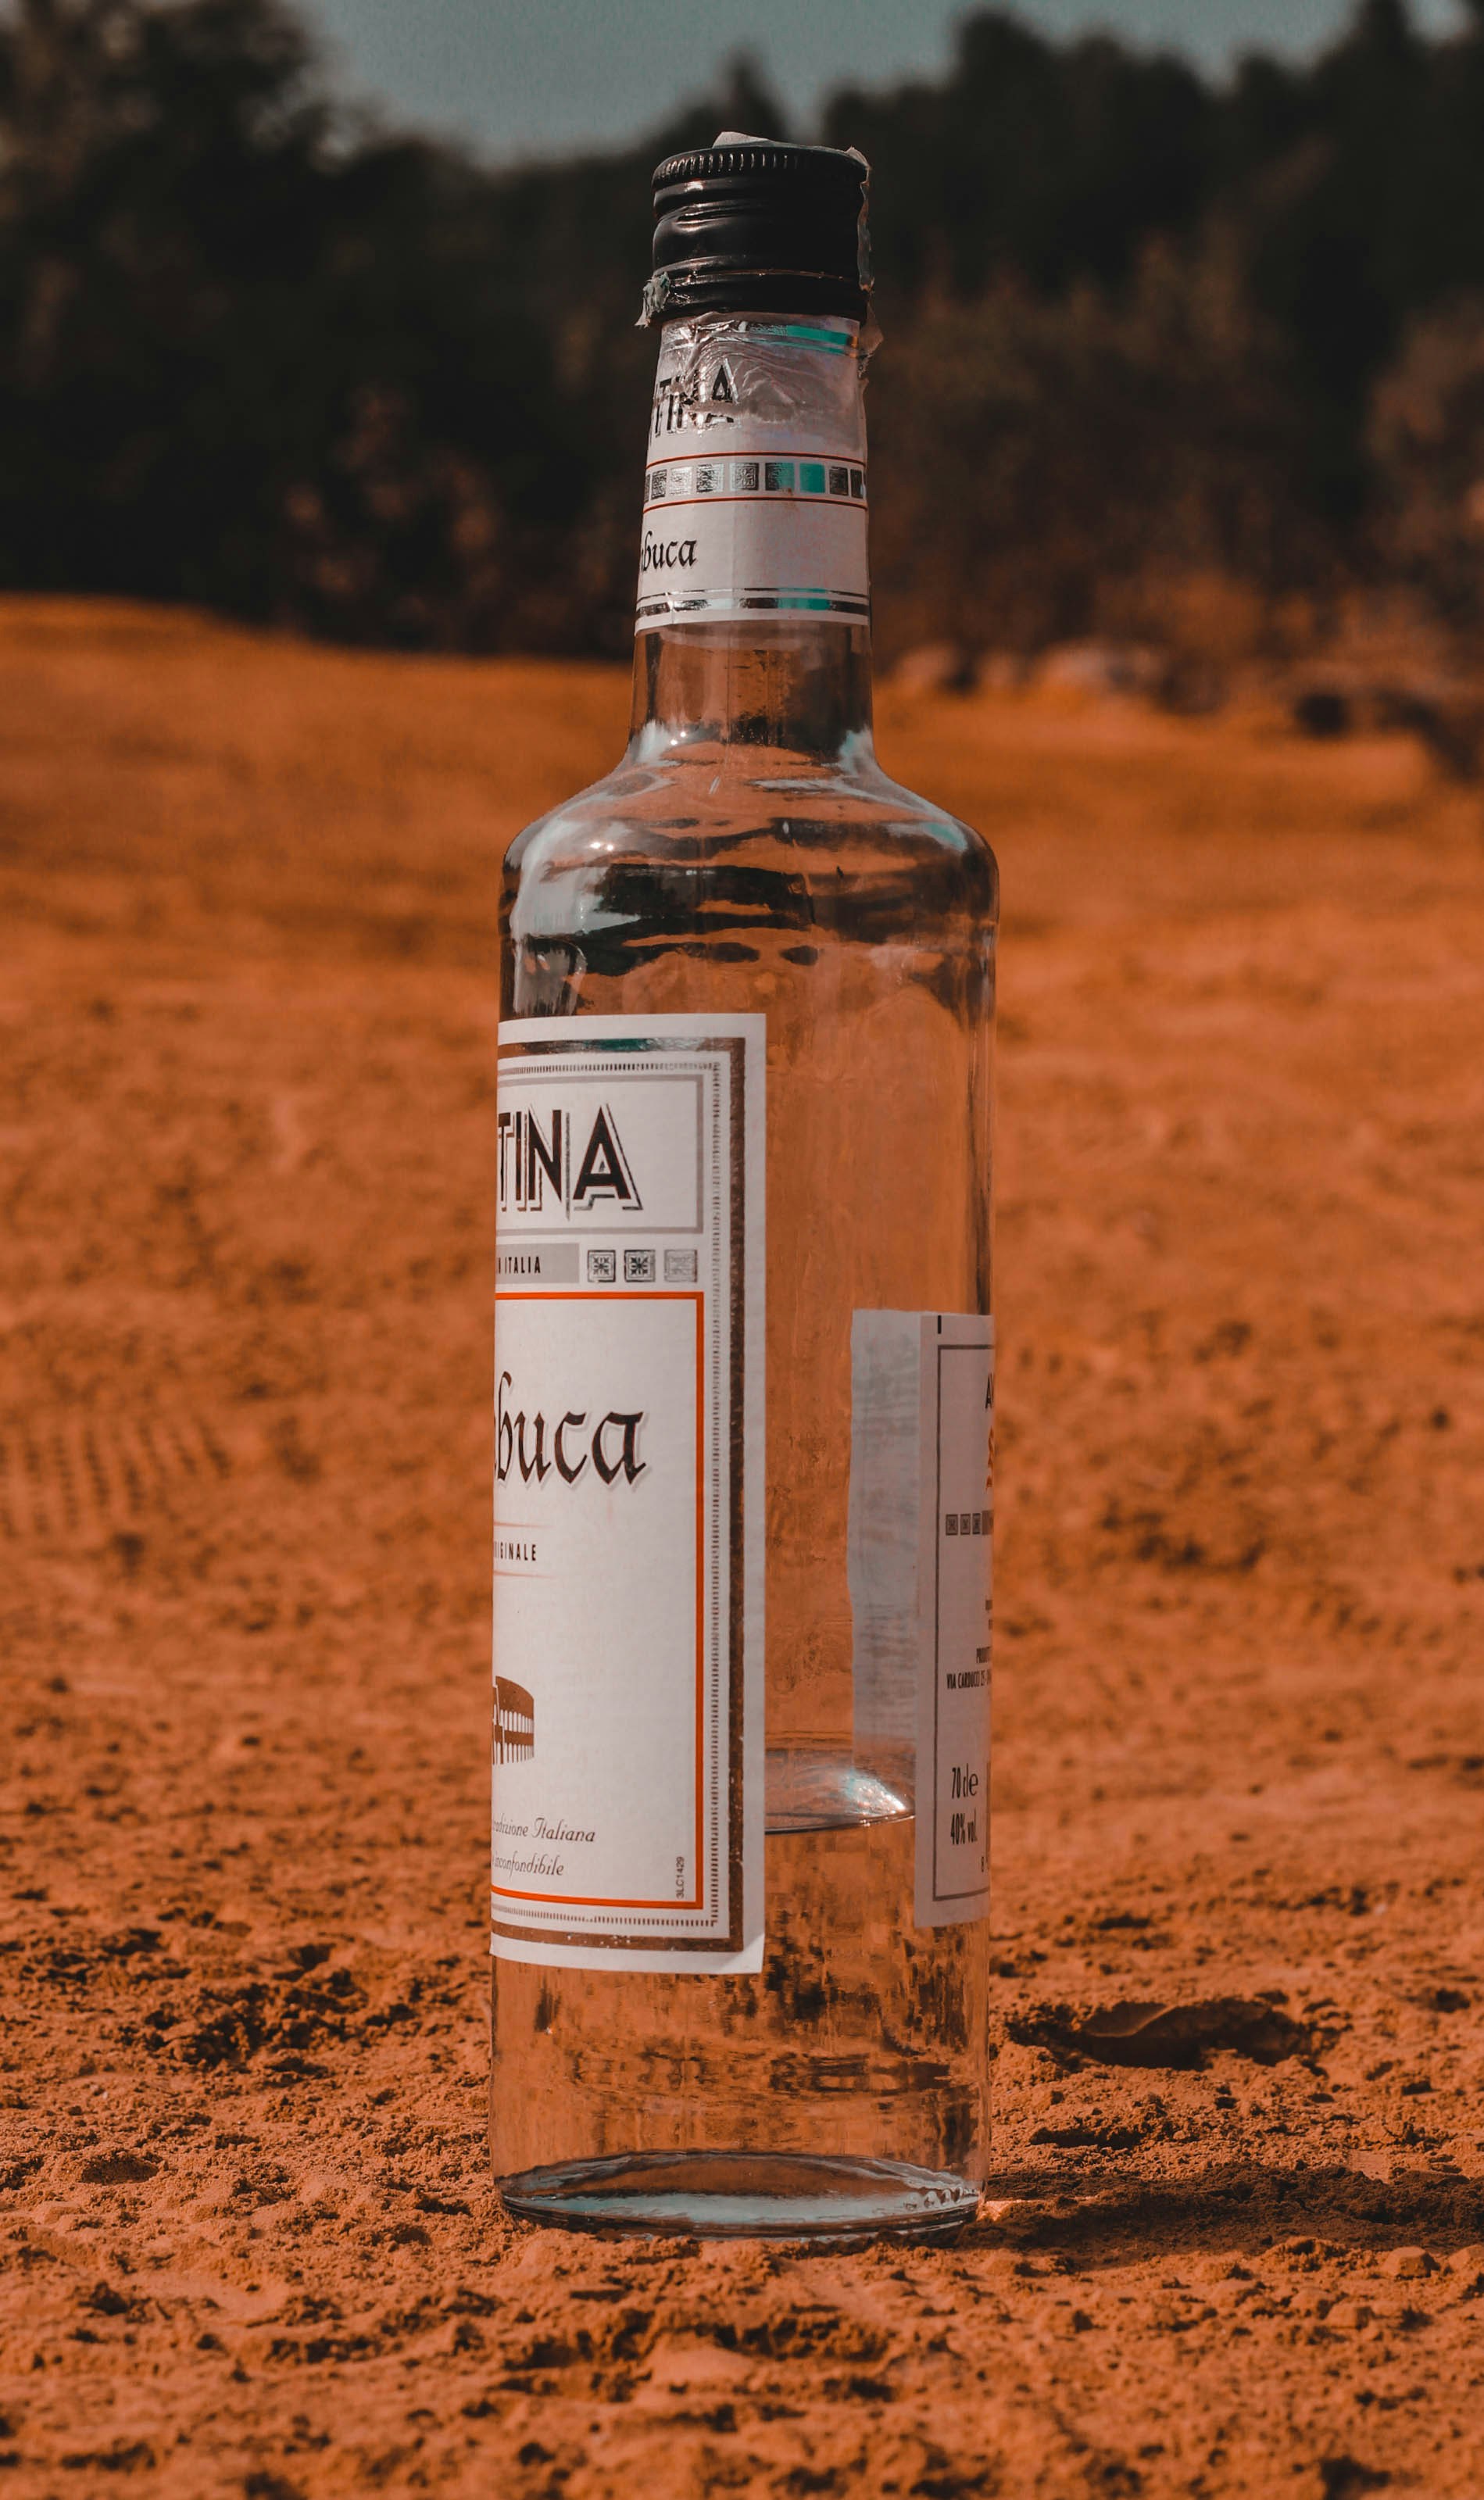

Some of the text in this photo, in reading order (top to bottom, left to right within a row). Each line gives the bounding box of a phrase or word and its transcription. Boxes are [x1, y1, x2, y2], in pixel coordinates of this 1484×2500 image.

[505, 1256, 541, 1274] ITALIA
[494, 1371, 647, 1486] buca
[532, 1817, 596, 1843] Italiana
